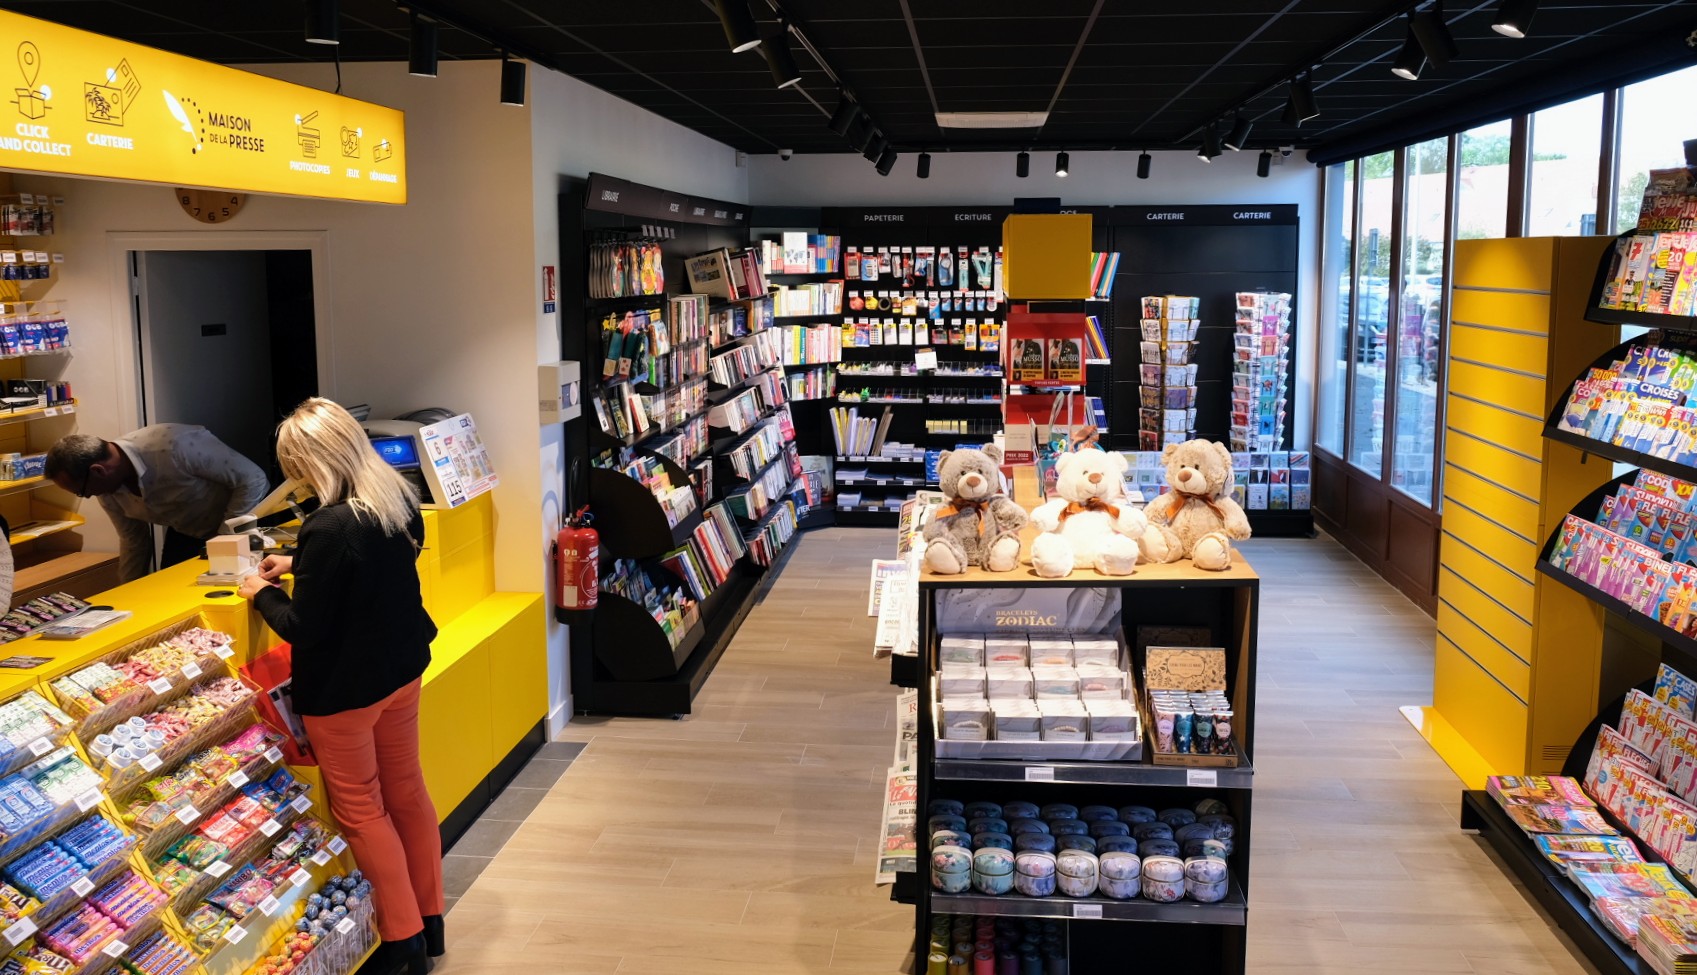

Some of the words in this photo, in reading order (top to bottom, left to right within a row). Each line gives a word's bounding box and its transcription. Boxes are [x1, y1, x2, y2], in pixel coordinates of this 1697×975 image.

[209, 111, 251, 132] MAISON
[16, 123, 49, 139] CLICK
[0, 136, 22, 151] AND
[23, 140, 72, 156] COLLECT
[86, 132, 134, 150] CARTERIE
[210, 133, 218, 143] DE
[219, 136, 228, 144] LA
[229, 134, 264, 152] PRESSE
[289, 161, 330, 175] PHOTOCOPIES
[346, 168, 360, 179] JEUX
[182, 196, 190, 205] 8
[230, 196, 238, 206] 4
[193, 207, 201, 217] 7
[208, 212, 216, 221] 6
[222, 207, 230, 216] 5
[955, 213, 992, 221] ECRITURE
[1147, 212, 1184, 220] CARTERIE
[1233, 211, 1271, 219] CARTERIE
[864, 214, 904, 222] PAPETERIE
[1668, 252, 1683, 262] 20
[447, 480, 463, 497] 115
[995, 615, 1057, 626] ZODIAC
[26, 863, 54, 882] mentos
[39, 874, 67, 893] mentos
[74, 934, 102, 953] mentos
[142, 949, 166, 969] mentos
